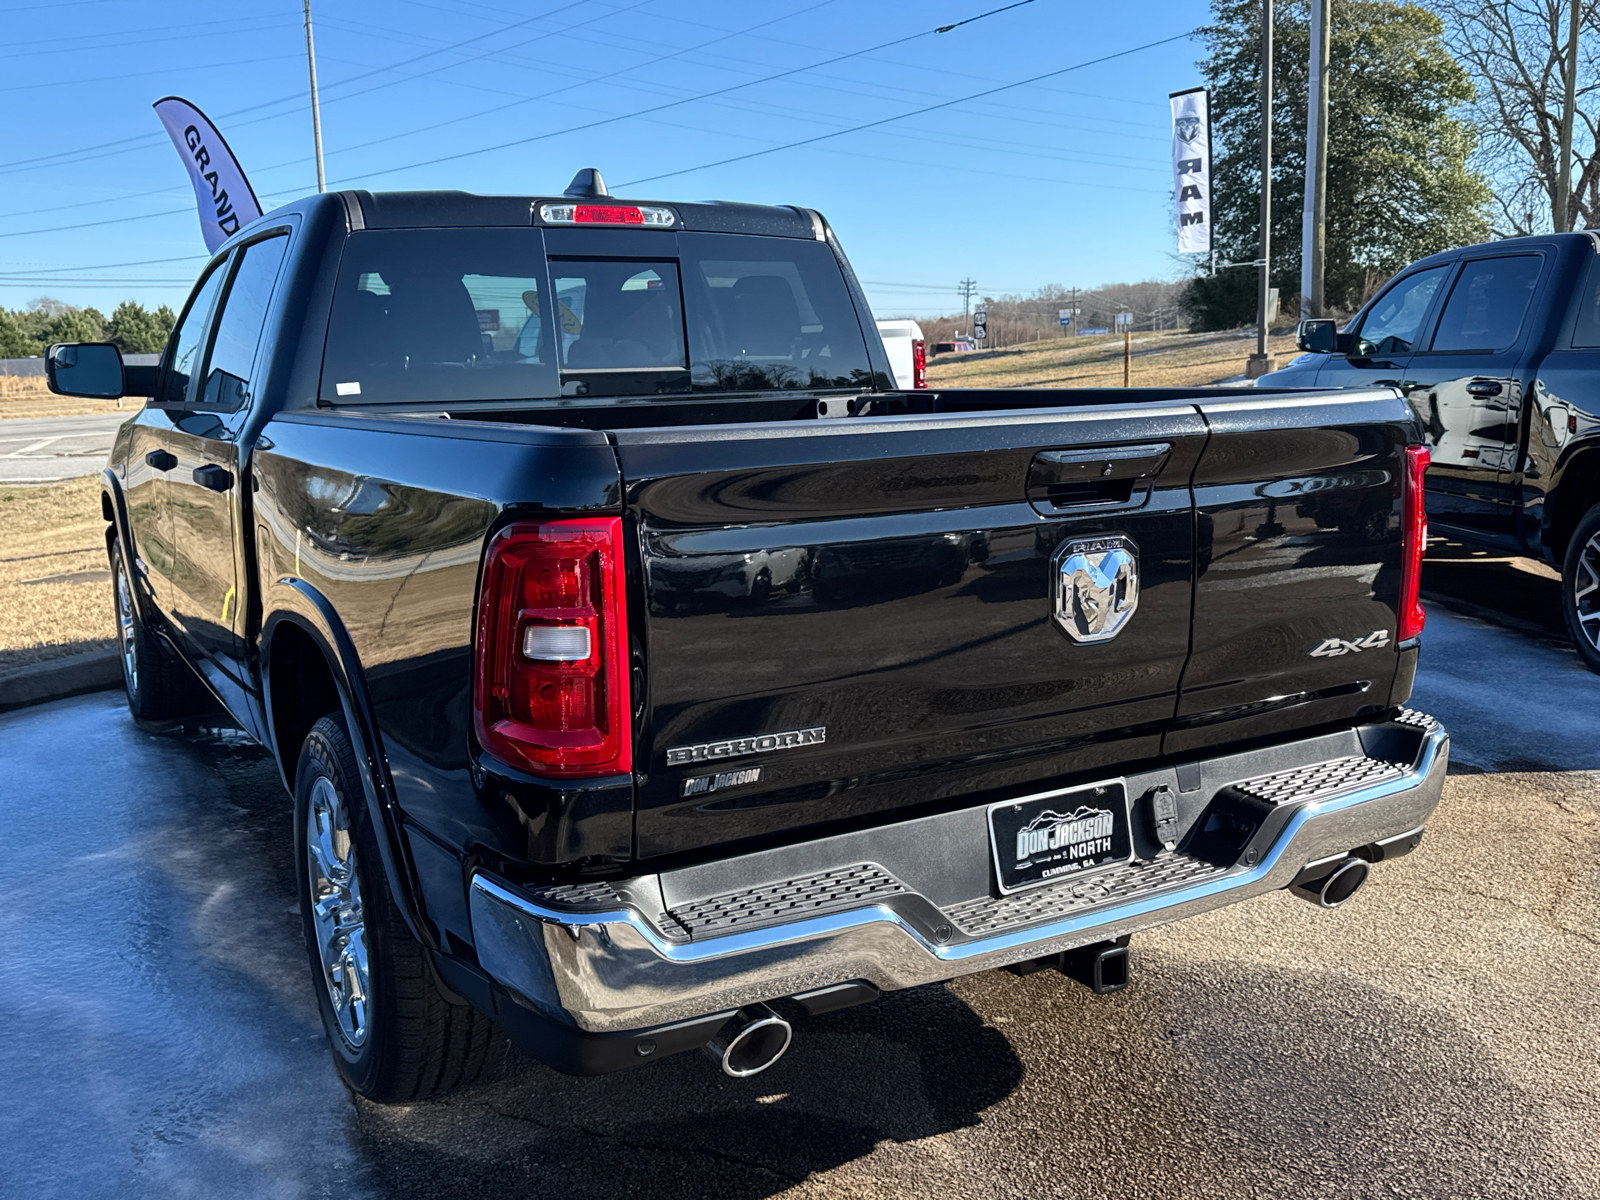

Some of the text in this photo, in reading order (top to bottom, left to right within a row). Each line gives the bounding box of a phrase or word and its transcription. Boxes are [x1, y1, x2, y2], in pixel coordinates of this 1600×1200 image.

[184, 124, 240, 237] GRAND
[1073, 540, 1124, 553] RAM
[666, 726, 826, 767] BIGHORN
[683, 768, 761, 797] DON JACKSON
[1016, 829, 1050, 860] DON
[1049, 813, 1114, 850] JACKSON
[1069, 837, 1112, 859] NORTH
[1082, 858, 1096, 868] GA
